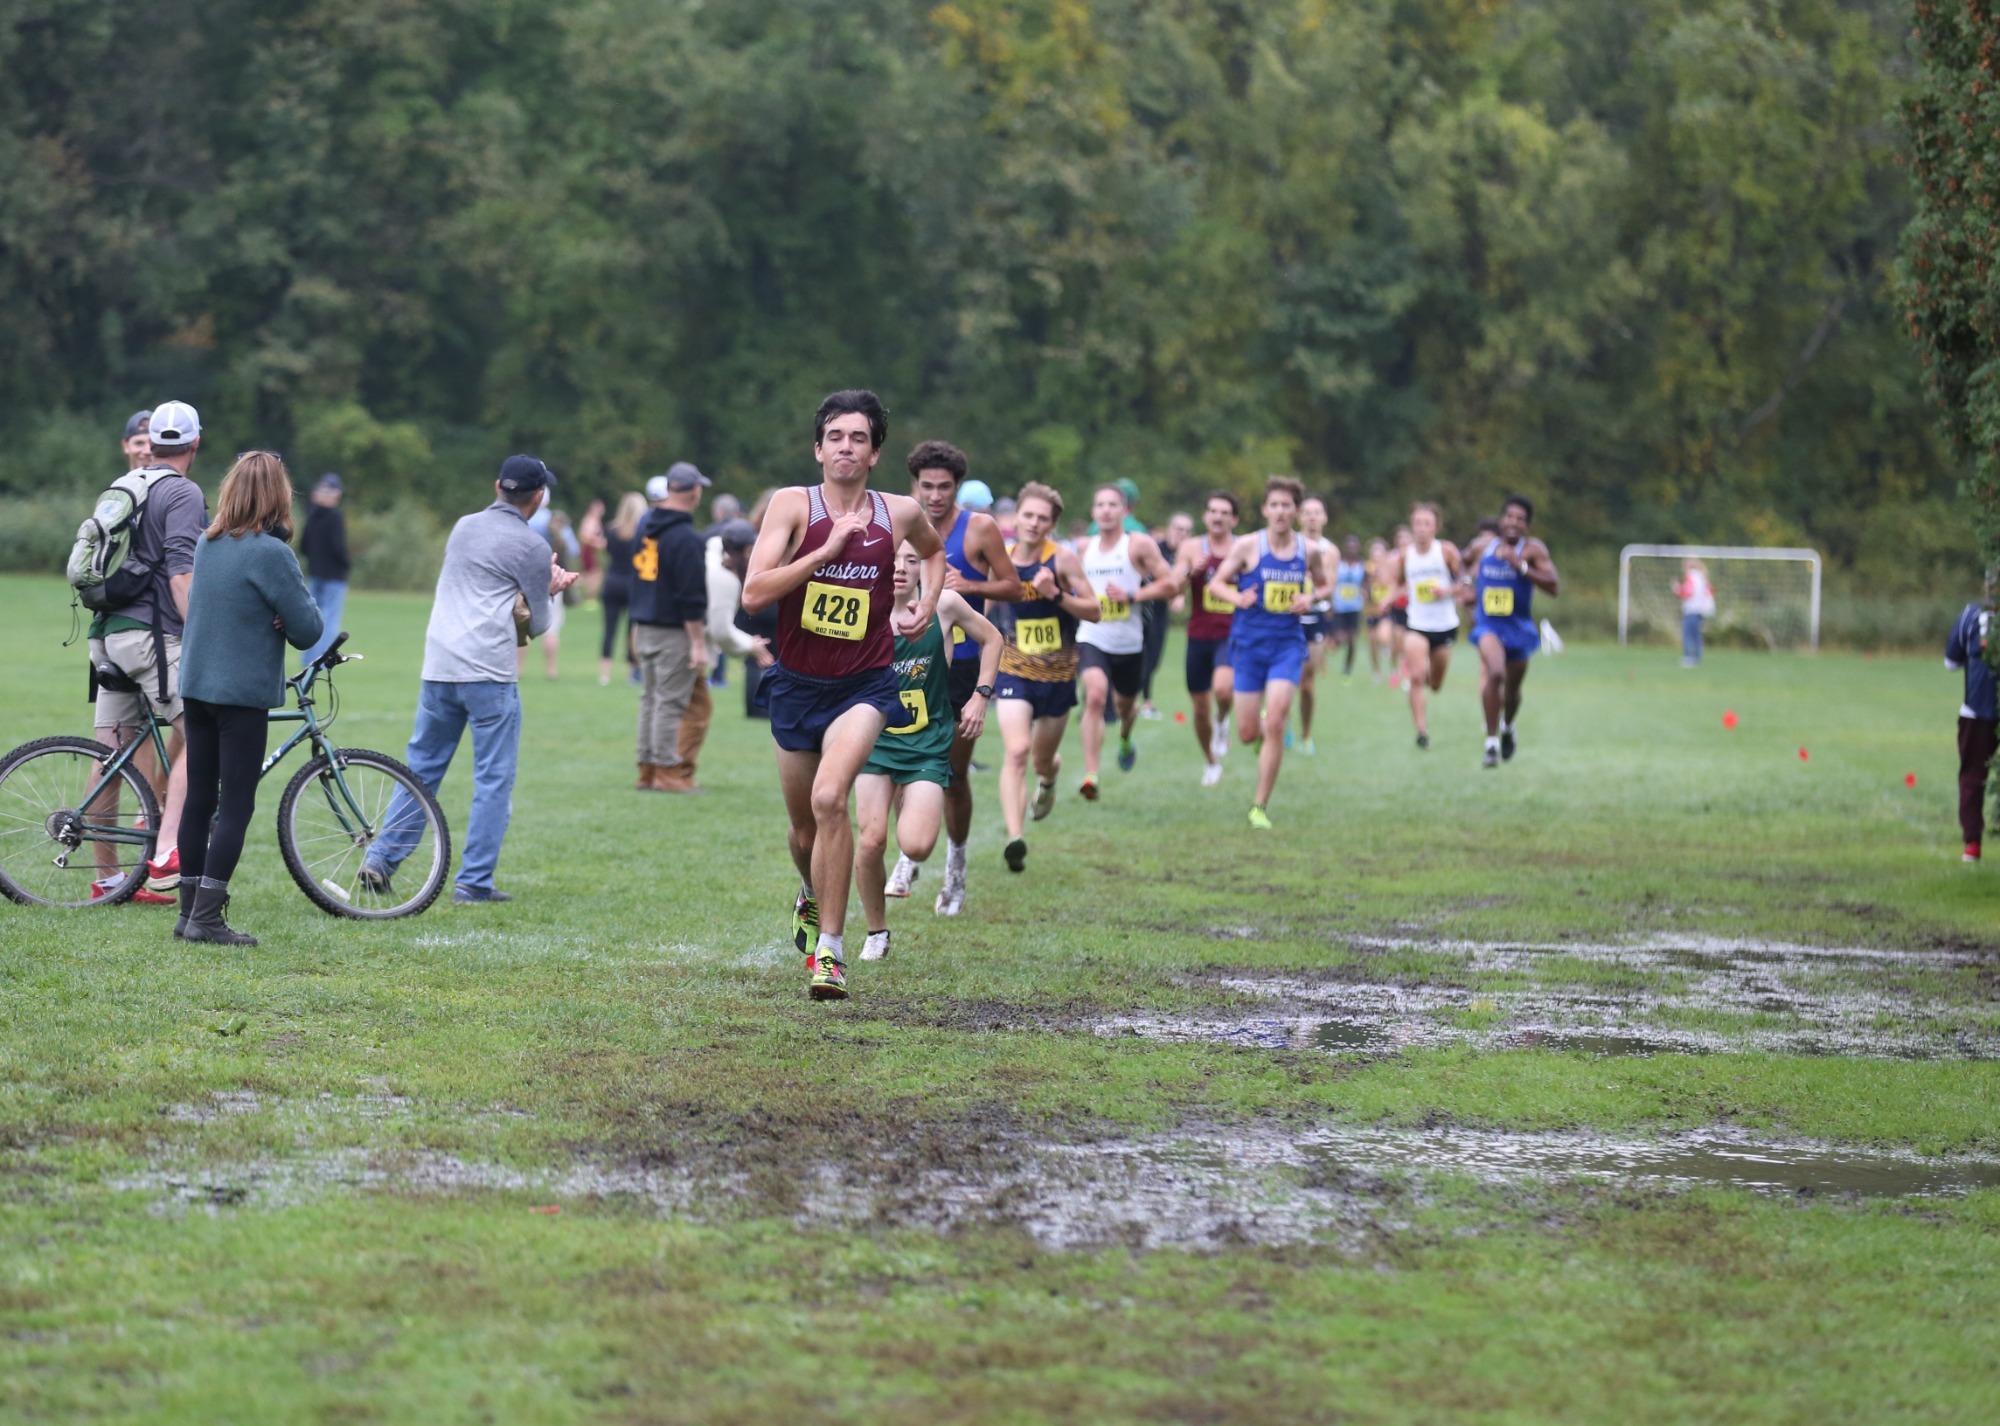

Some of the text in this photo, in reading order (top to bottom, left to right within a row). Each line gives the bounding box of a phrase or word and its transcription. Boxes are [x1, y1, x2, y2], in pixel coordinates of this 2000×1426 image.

[812, 593, 860, 626] 428
[829, 629, 850, 637] TIMING
[1024, 625, 1054, 644] 708
[890, 656, 932, 669] TCHBURG
